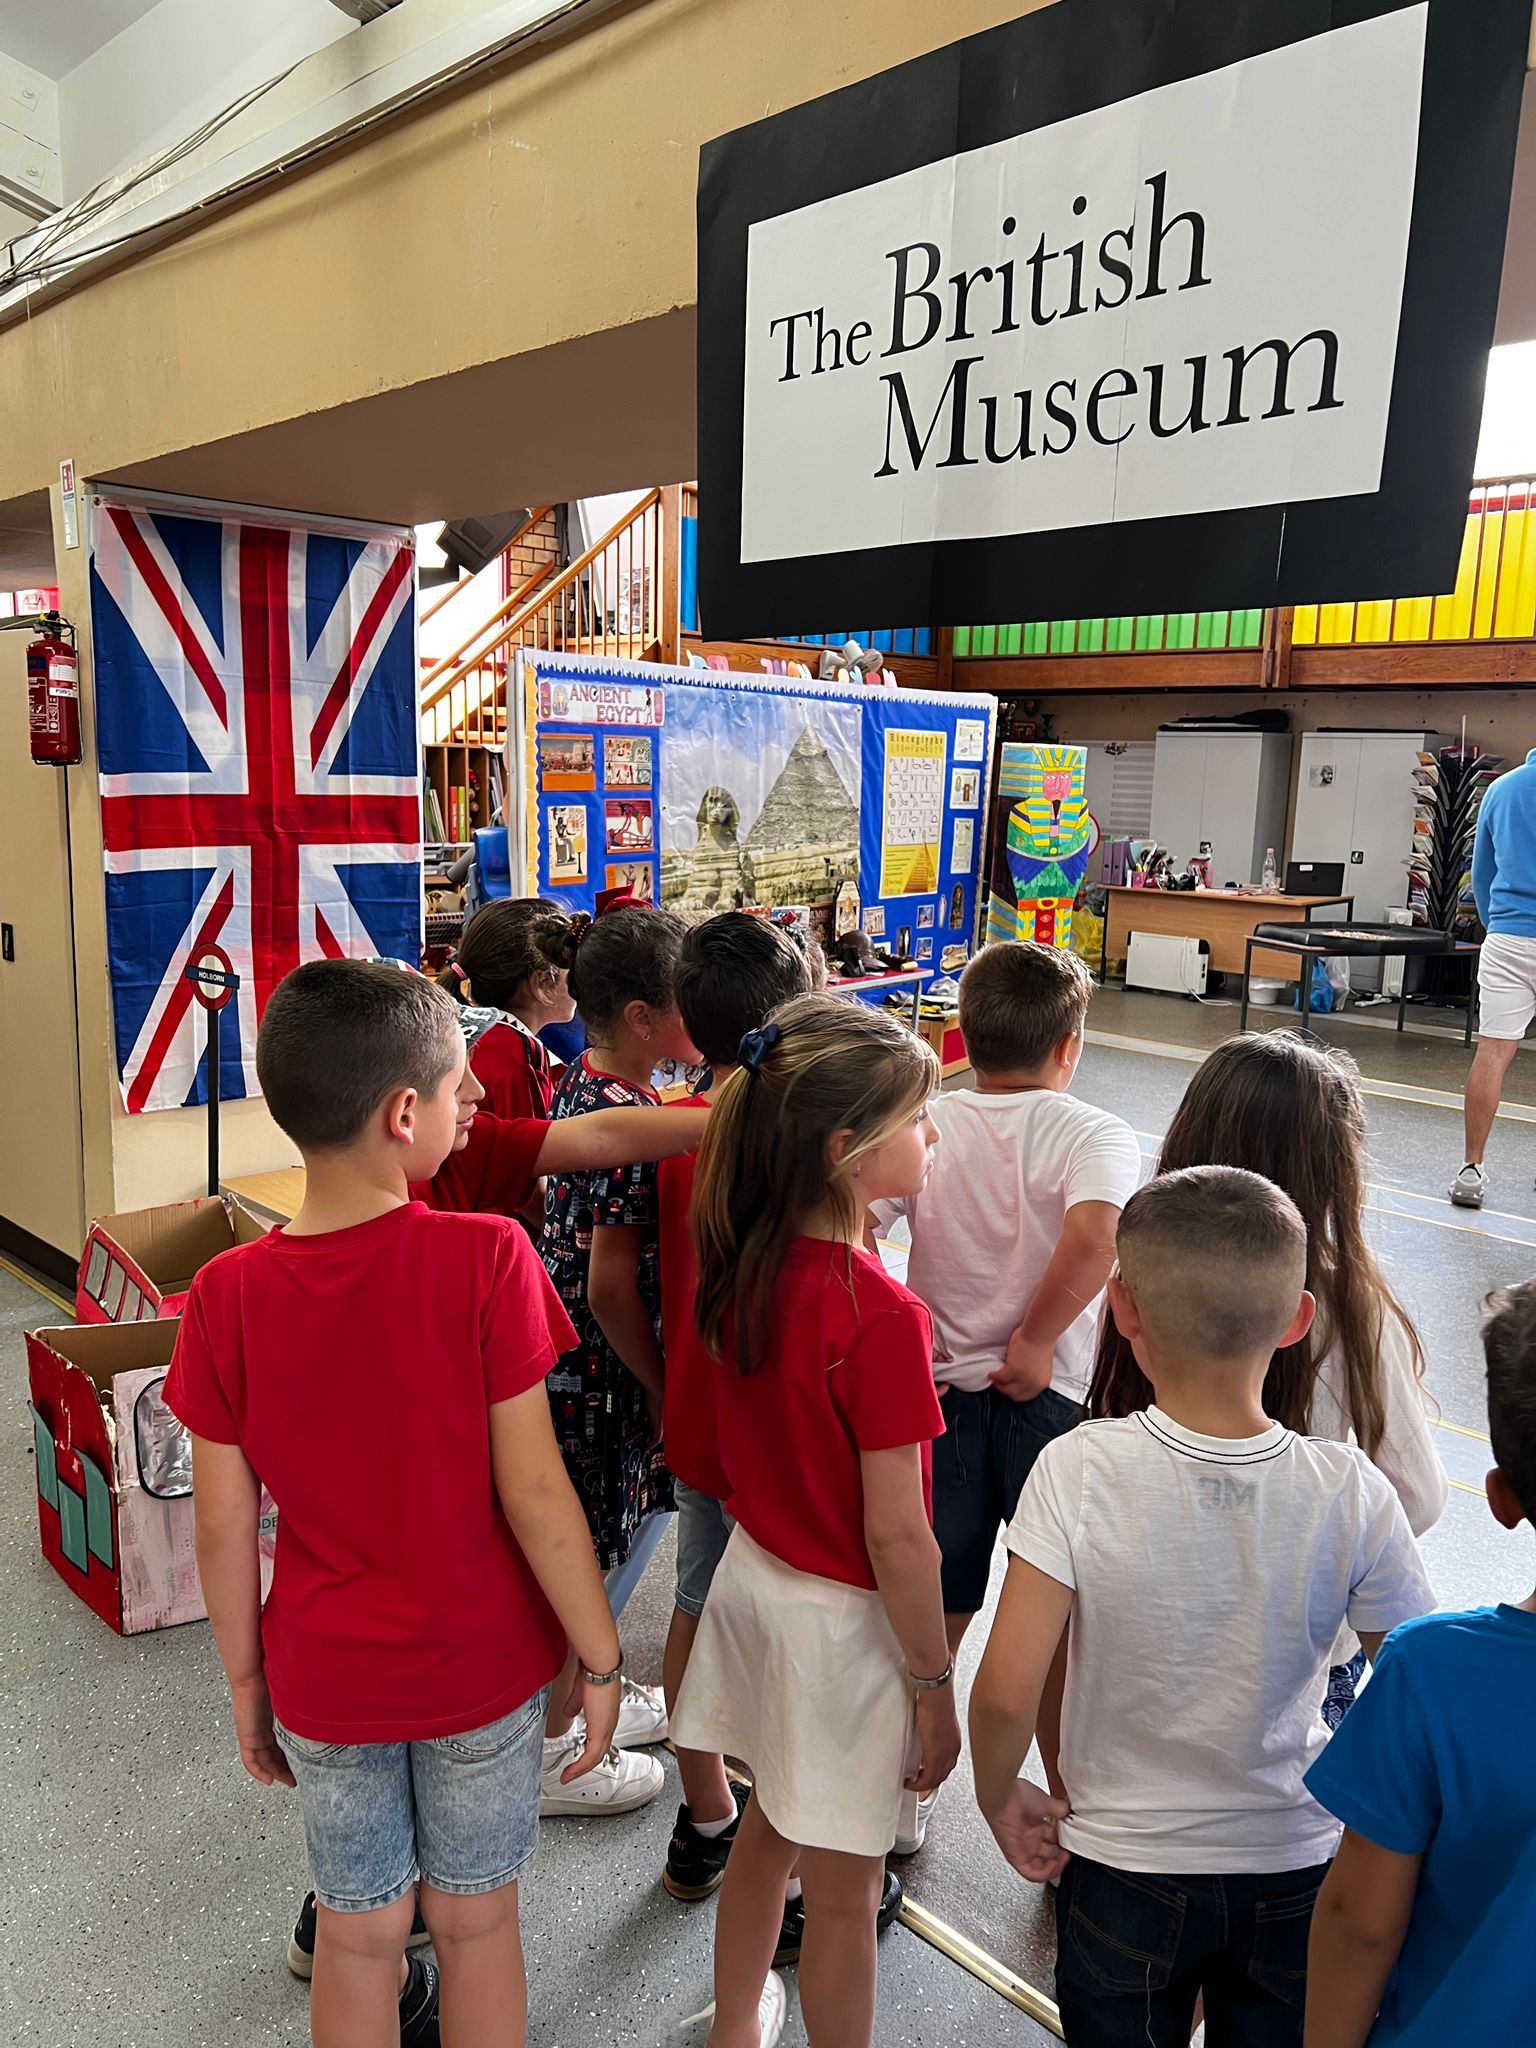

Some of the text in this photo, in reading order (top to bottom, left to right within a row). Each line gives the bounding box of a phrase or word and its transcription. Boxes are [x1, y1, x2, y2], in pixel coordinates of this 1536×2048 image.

[770, 170, 1212, 382] The British
[873, 325, 1344, 478] Museum
[570, 684, 632, 704] ANCIENT
[596, 704, 643, 723] EGYPT
[198, 971, 225, 982] HOLBORN
